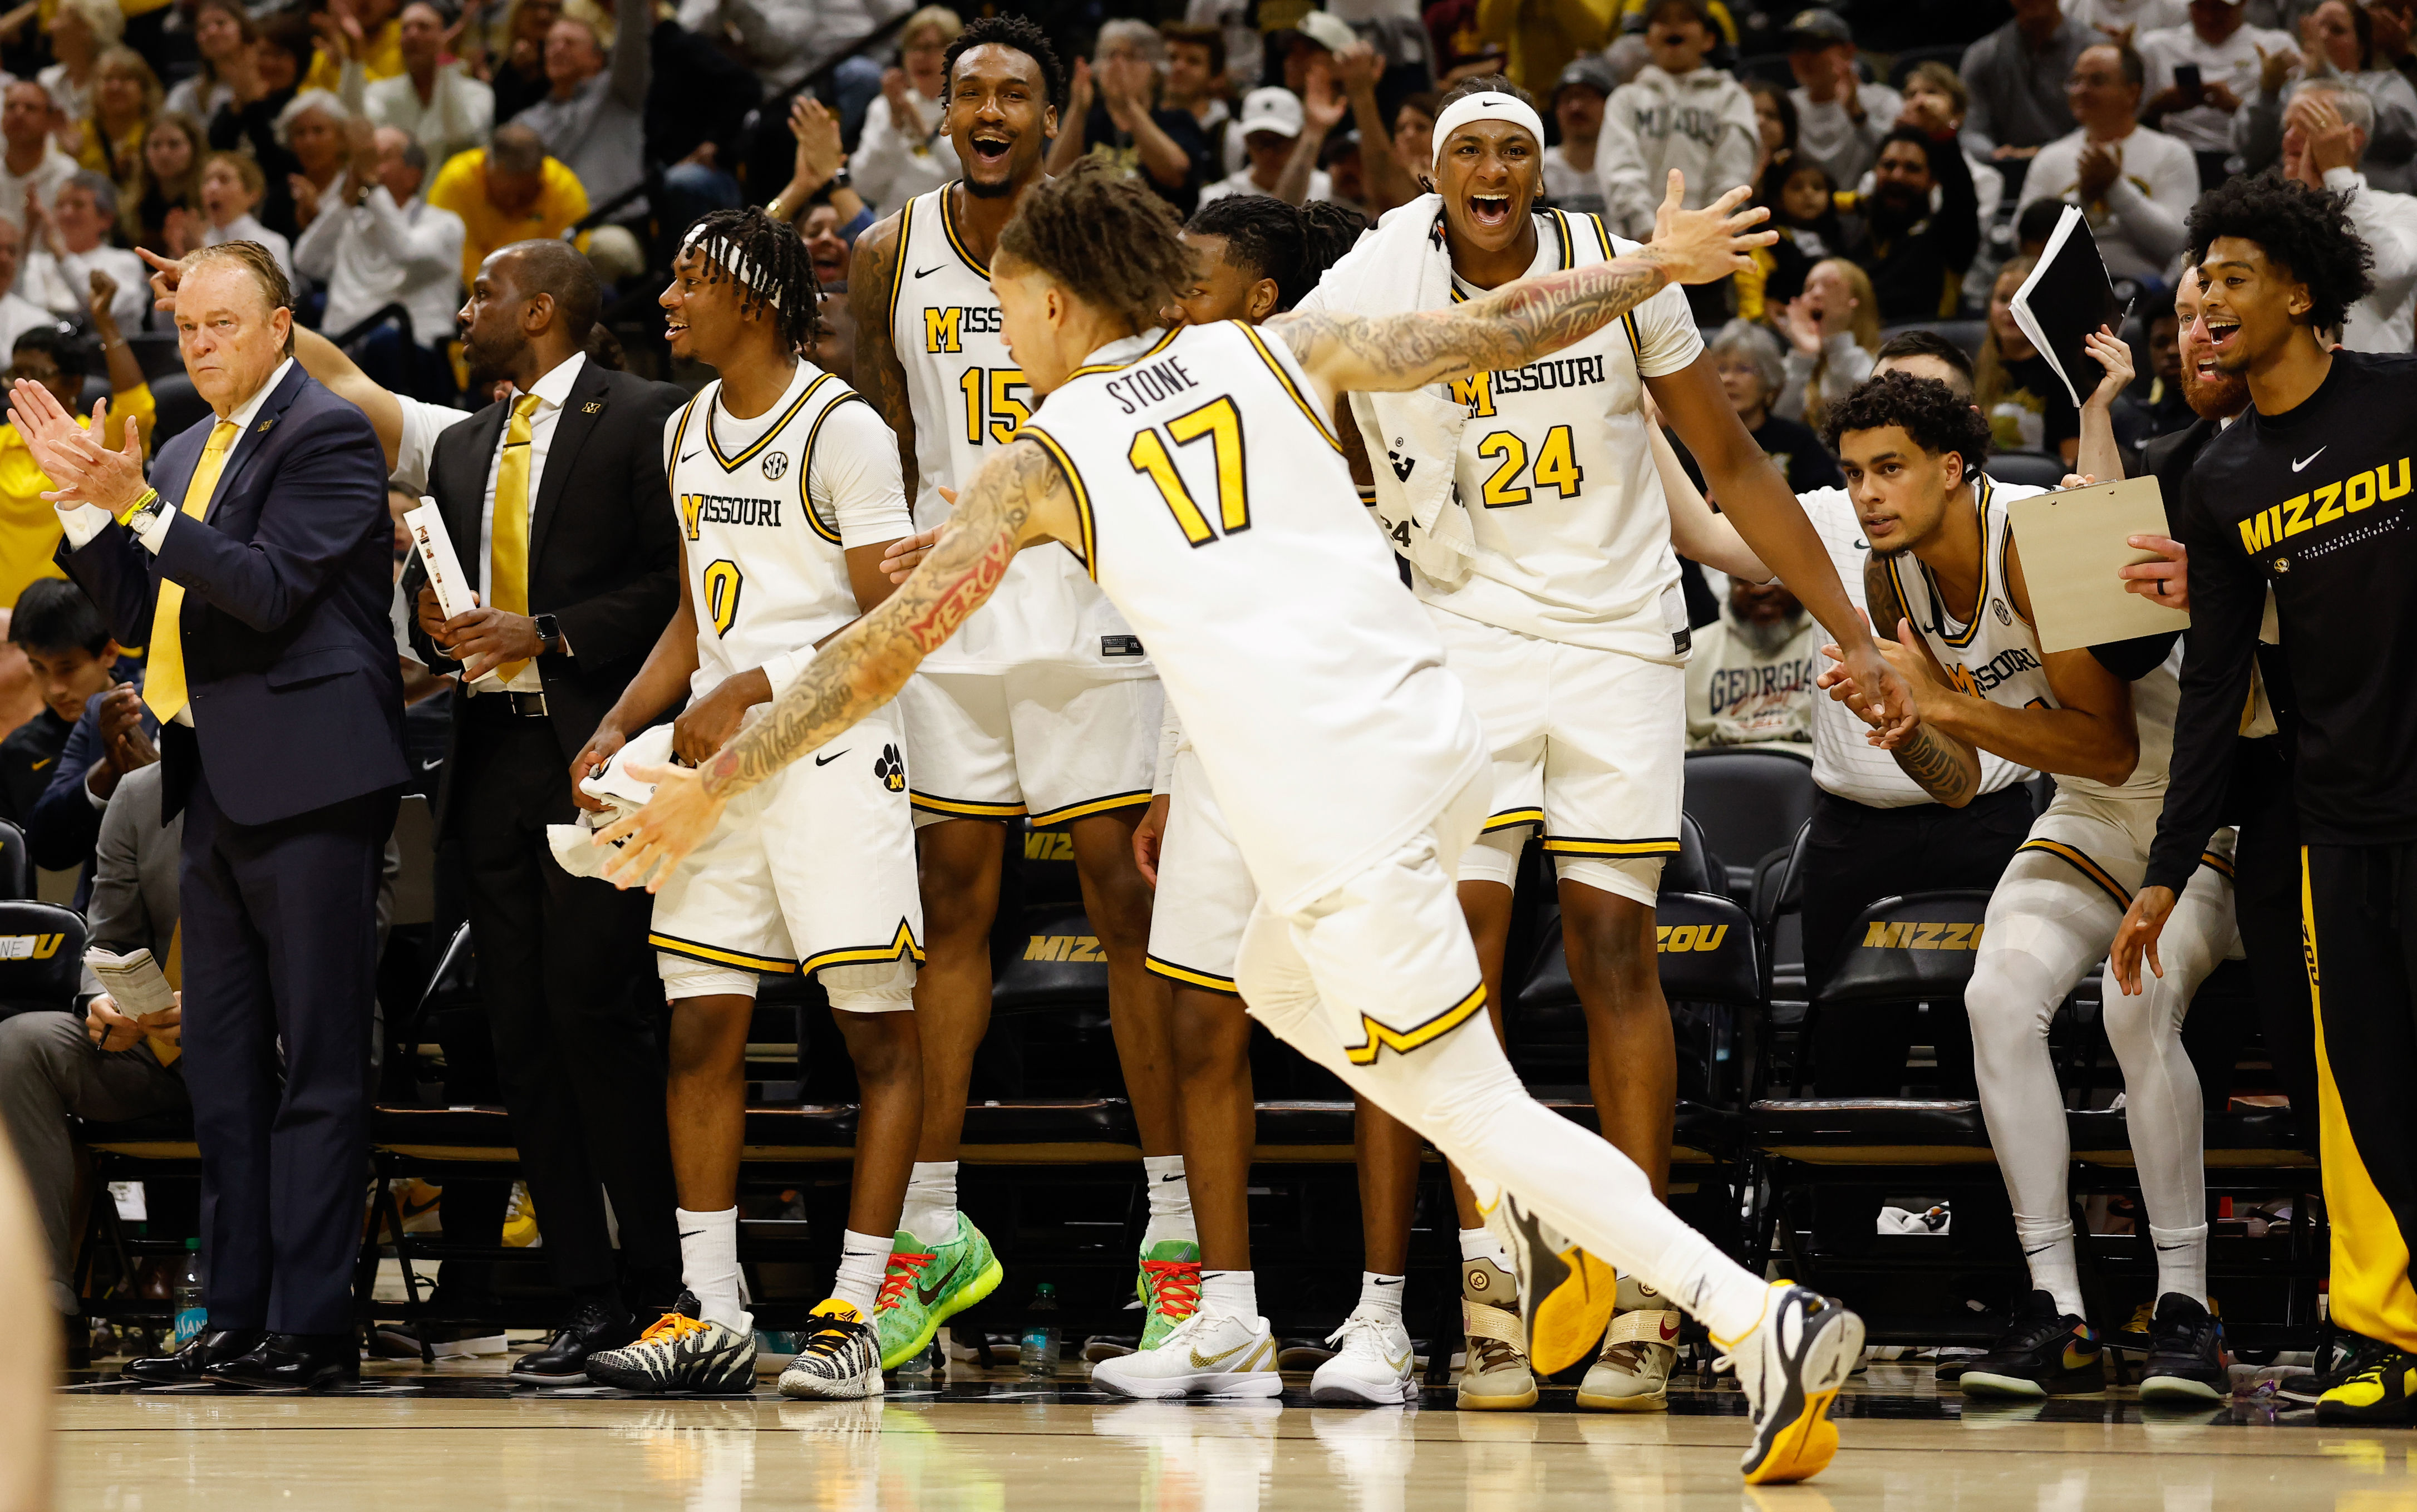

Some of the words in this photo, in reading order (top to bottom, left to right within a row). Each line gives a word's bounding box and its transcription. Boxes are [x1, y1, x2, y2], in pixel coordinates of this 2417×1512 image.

[1510, 272, 1629, 336] Walking
[924, 307, 1003, 353] MISS
[959, 366, 1034, 446] 15
[1106, 355, 1199, 414] STONE
[1448, 355, 1605, 419] MISSOURI
[763, 452, 792, 480] SEC
[1127, 393, 1251, 549] 17
[1477, 424, 1584, 509] 24
[138, 494, 152, 507] NEVER
[681, 493, 781, 541] MISSOURI
[2238, 456, 2411, 555] MIZZOU
[2297, 526, 2369, 556] ENGINEERED
[2378, 516, 2400, 527] FOR
[2339, 524, 2395, 547] BASKETBALL
[703, 559, 744, 639] 0
[918, 536, 1006, 652] MERCY
[889, 774, 904, 789] M
[1025, 832, 1075, 860] MIZ
[1023, 935, 1109, 962] MIZ
[1656, 924, 1729, 952] ZOU
[1862, 921, 1985, 950] MIZZ
[175, 1315, 208, 1338] ASAN
